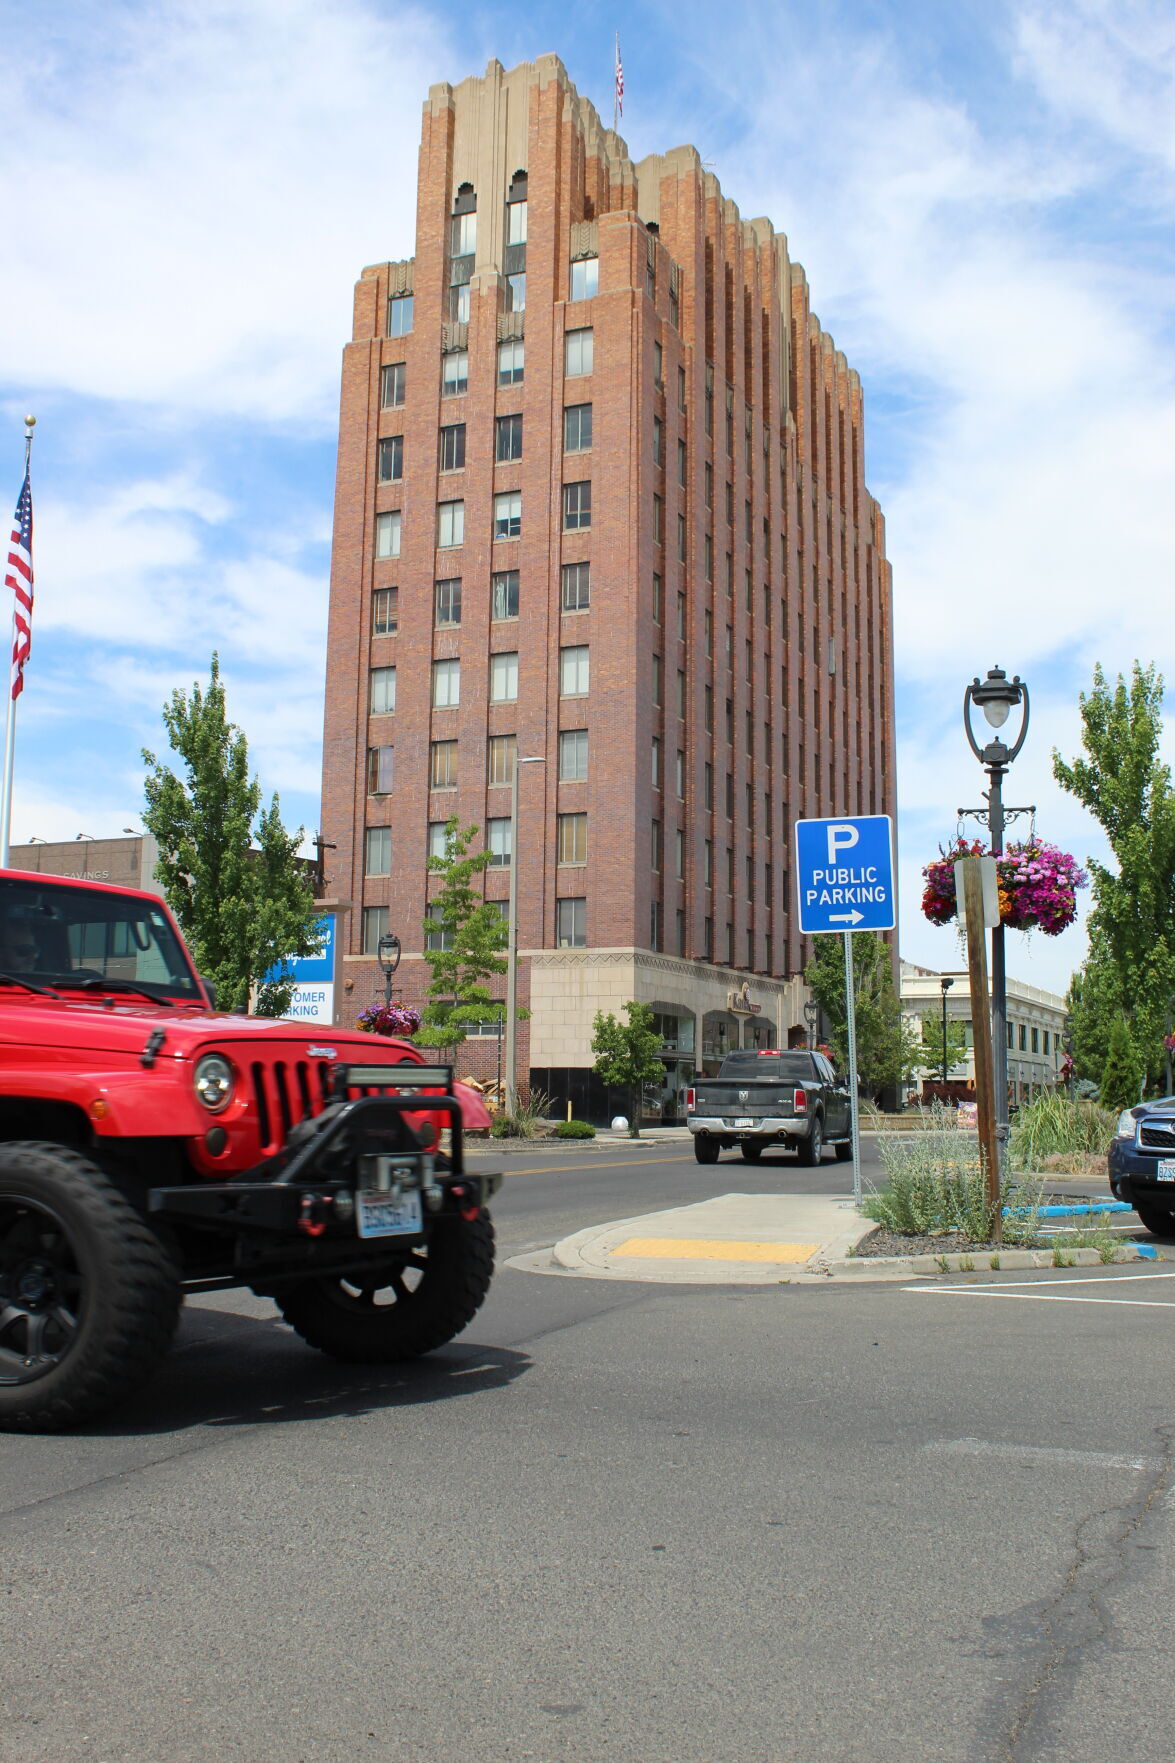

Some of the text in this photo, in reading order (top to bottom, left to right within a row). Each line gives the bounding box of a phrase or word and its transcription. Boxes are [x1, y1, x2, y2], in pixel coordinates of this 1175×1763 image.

[827, 824, 859, 864] P
[813, 867, 877, 885] PUBLIC
[806, 886, 886, 906] PARKING
[282, 1005, 319, 1016] RKING
